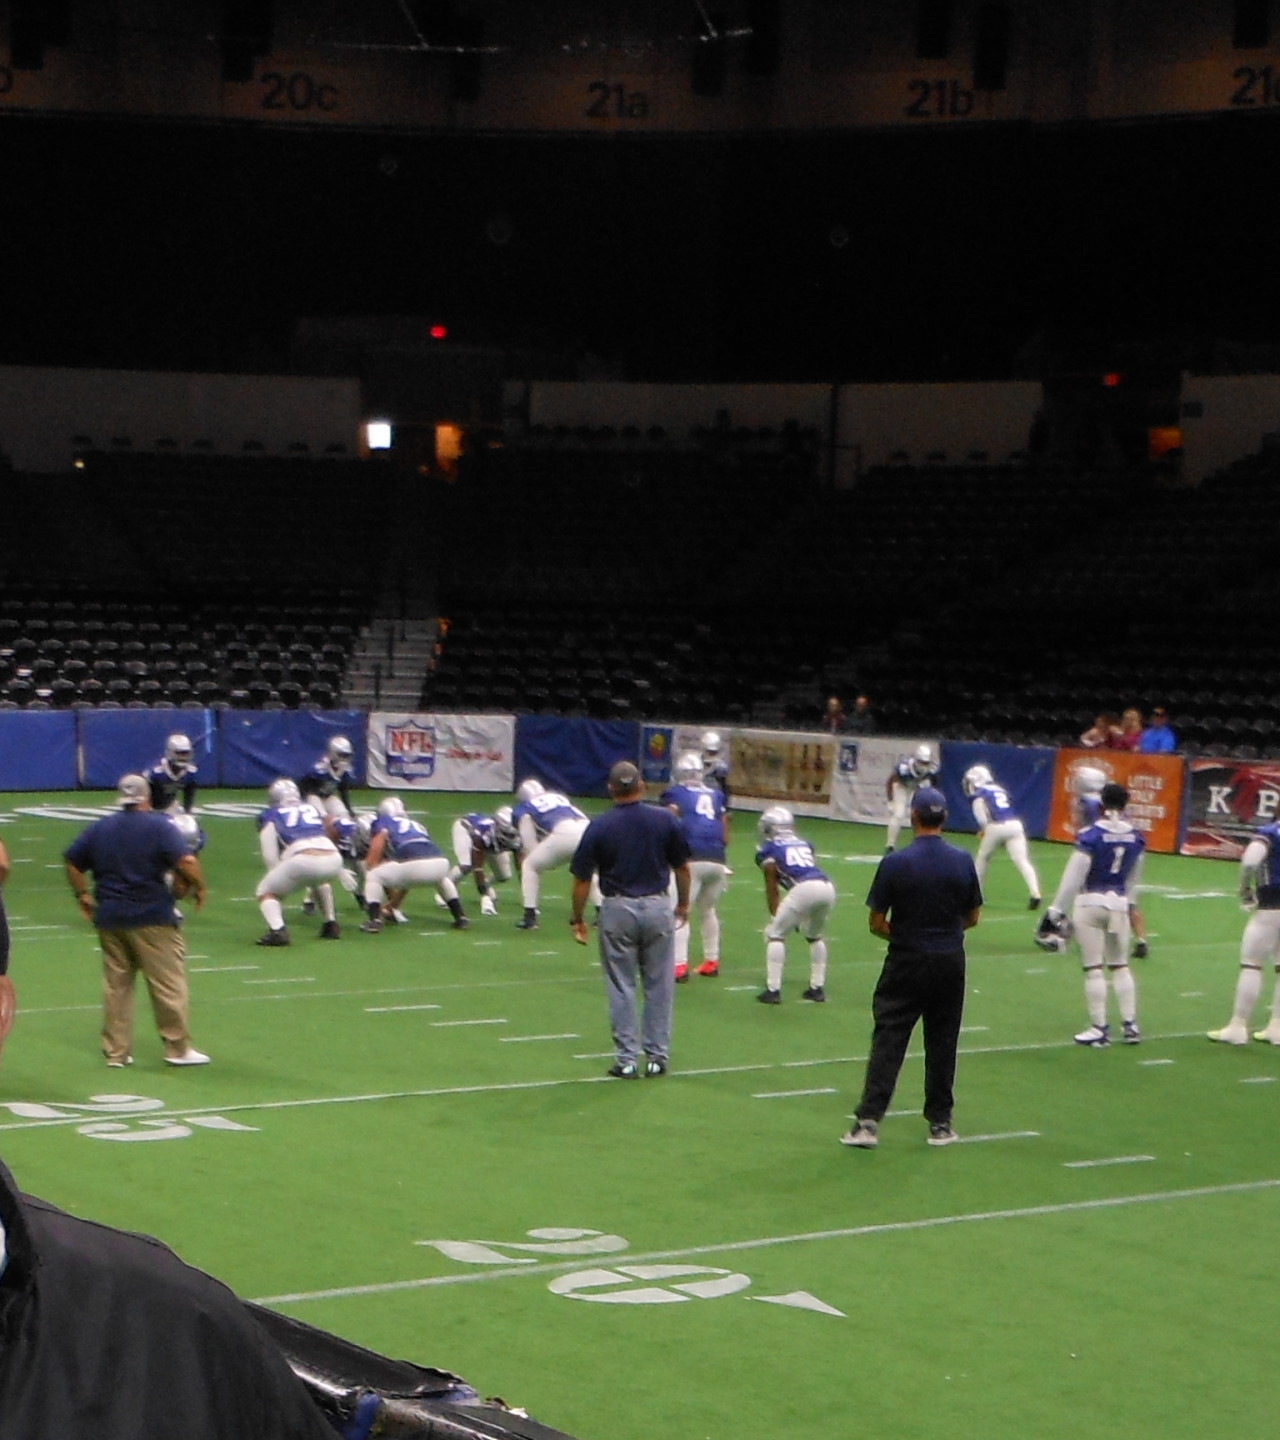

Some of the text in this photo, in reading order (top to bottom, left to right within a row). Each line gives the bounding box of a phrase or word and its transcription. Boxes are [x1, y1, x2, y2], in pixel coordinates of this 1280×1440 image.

[260, 72, 339, 111] 20c
[585, 82, 650, 119] 21a
[904, 80, 974, 117] 21b
[391, 731, 433, 753] NFL
[277, 803, 323, 828] 72
[694, 794, 716, 820] 4
[785, 845, 816, 868] 45
[1109, 845, 1126, 875] 1
